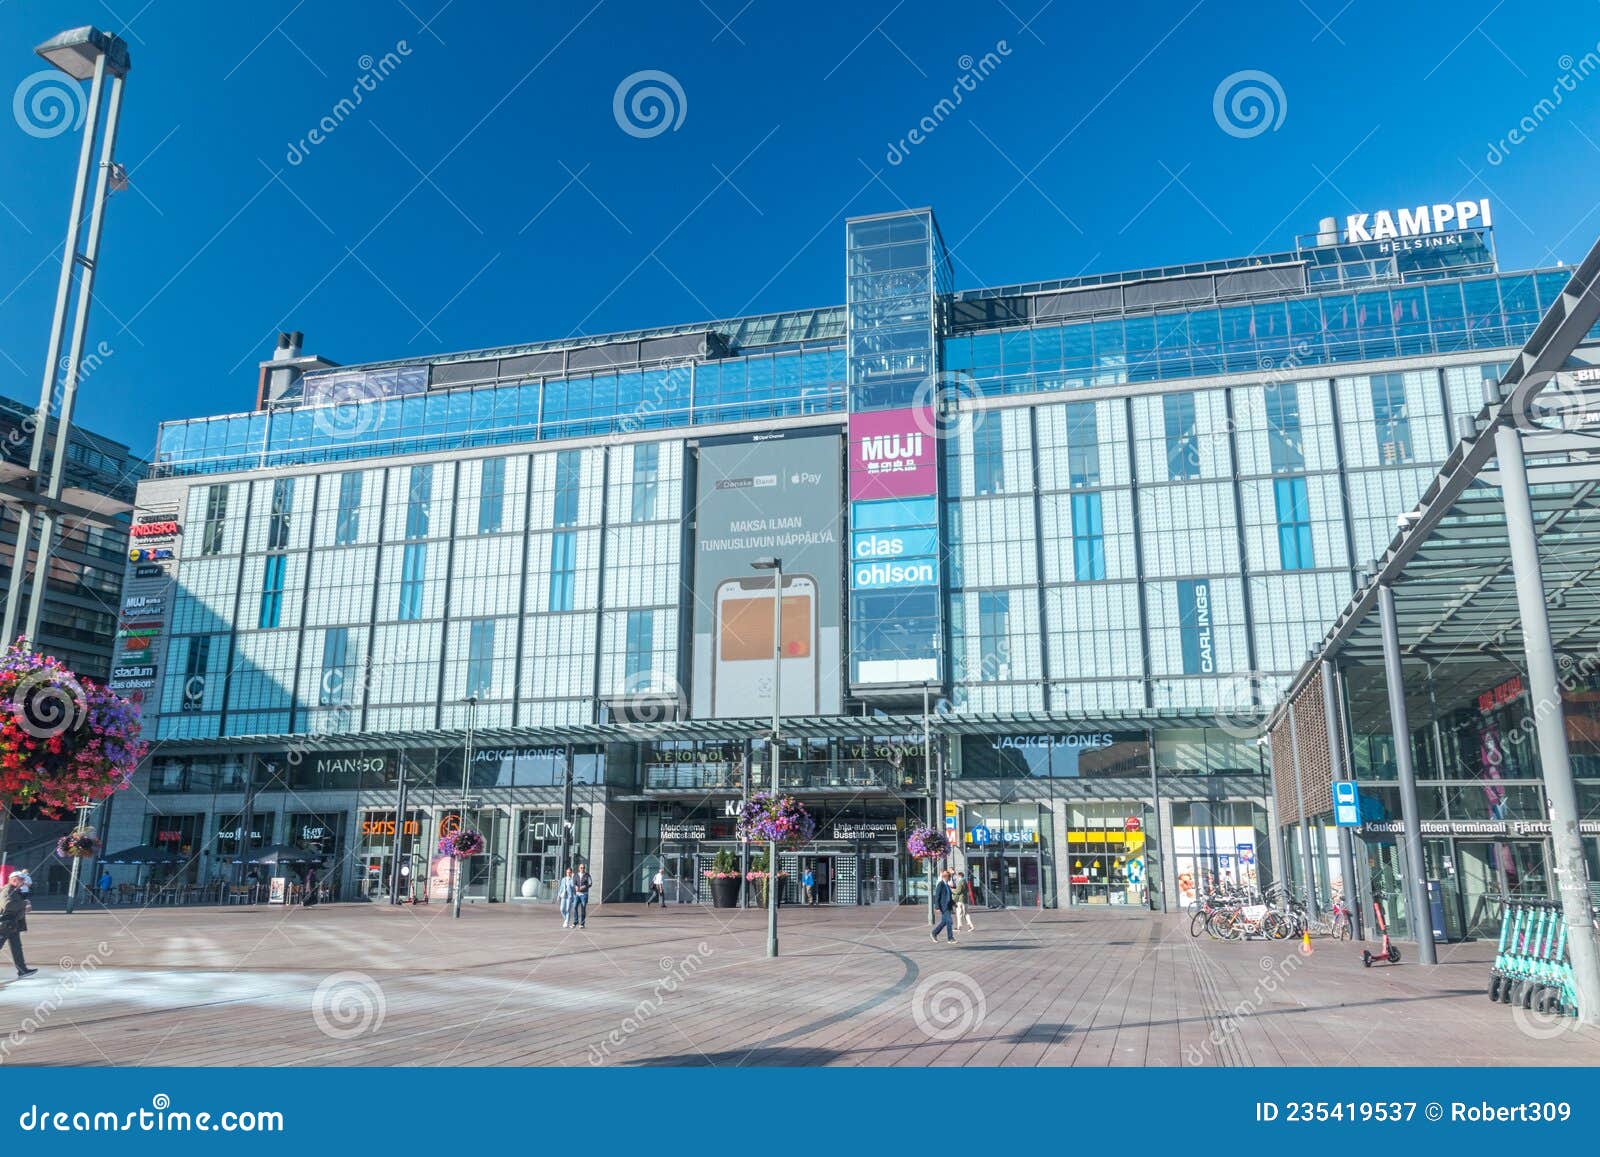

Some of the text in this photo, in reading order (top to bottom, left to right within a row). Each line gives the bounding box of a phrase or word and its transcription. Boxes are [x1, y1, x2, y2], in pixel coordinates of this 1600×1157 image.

[1346, 199, 1492, 243] KAMPPI
[1380, 234, 1463, 253] HELSINKI
[862, 432, 922, 461] MUJI
[801, 472, 822, 484] Pay
[730, 516, 802, 532] MAKSA ILMAN
[701, 535, 775, 551] TUNNUSLUVUN
[856, 534, 904, 557] clas
[856, 564, 933, 585] ohlson
[1195, 584, 1213, 673] CARLINGS
[114, 666, 153, 678] stadium
[317, 757, 384, 773] MANGO
[362, 820, 418, 836] synsm
[1366, 821, 1449, 832] Kaukolinteen
[1453, 821, 1506, 832] terminaali
[834, 831, 875, 840] Busstation
